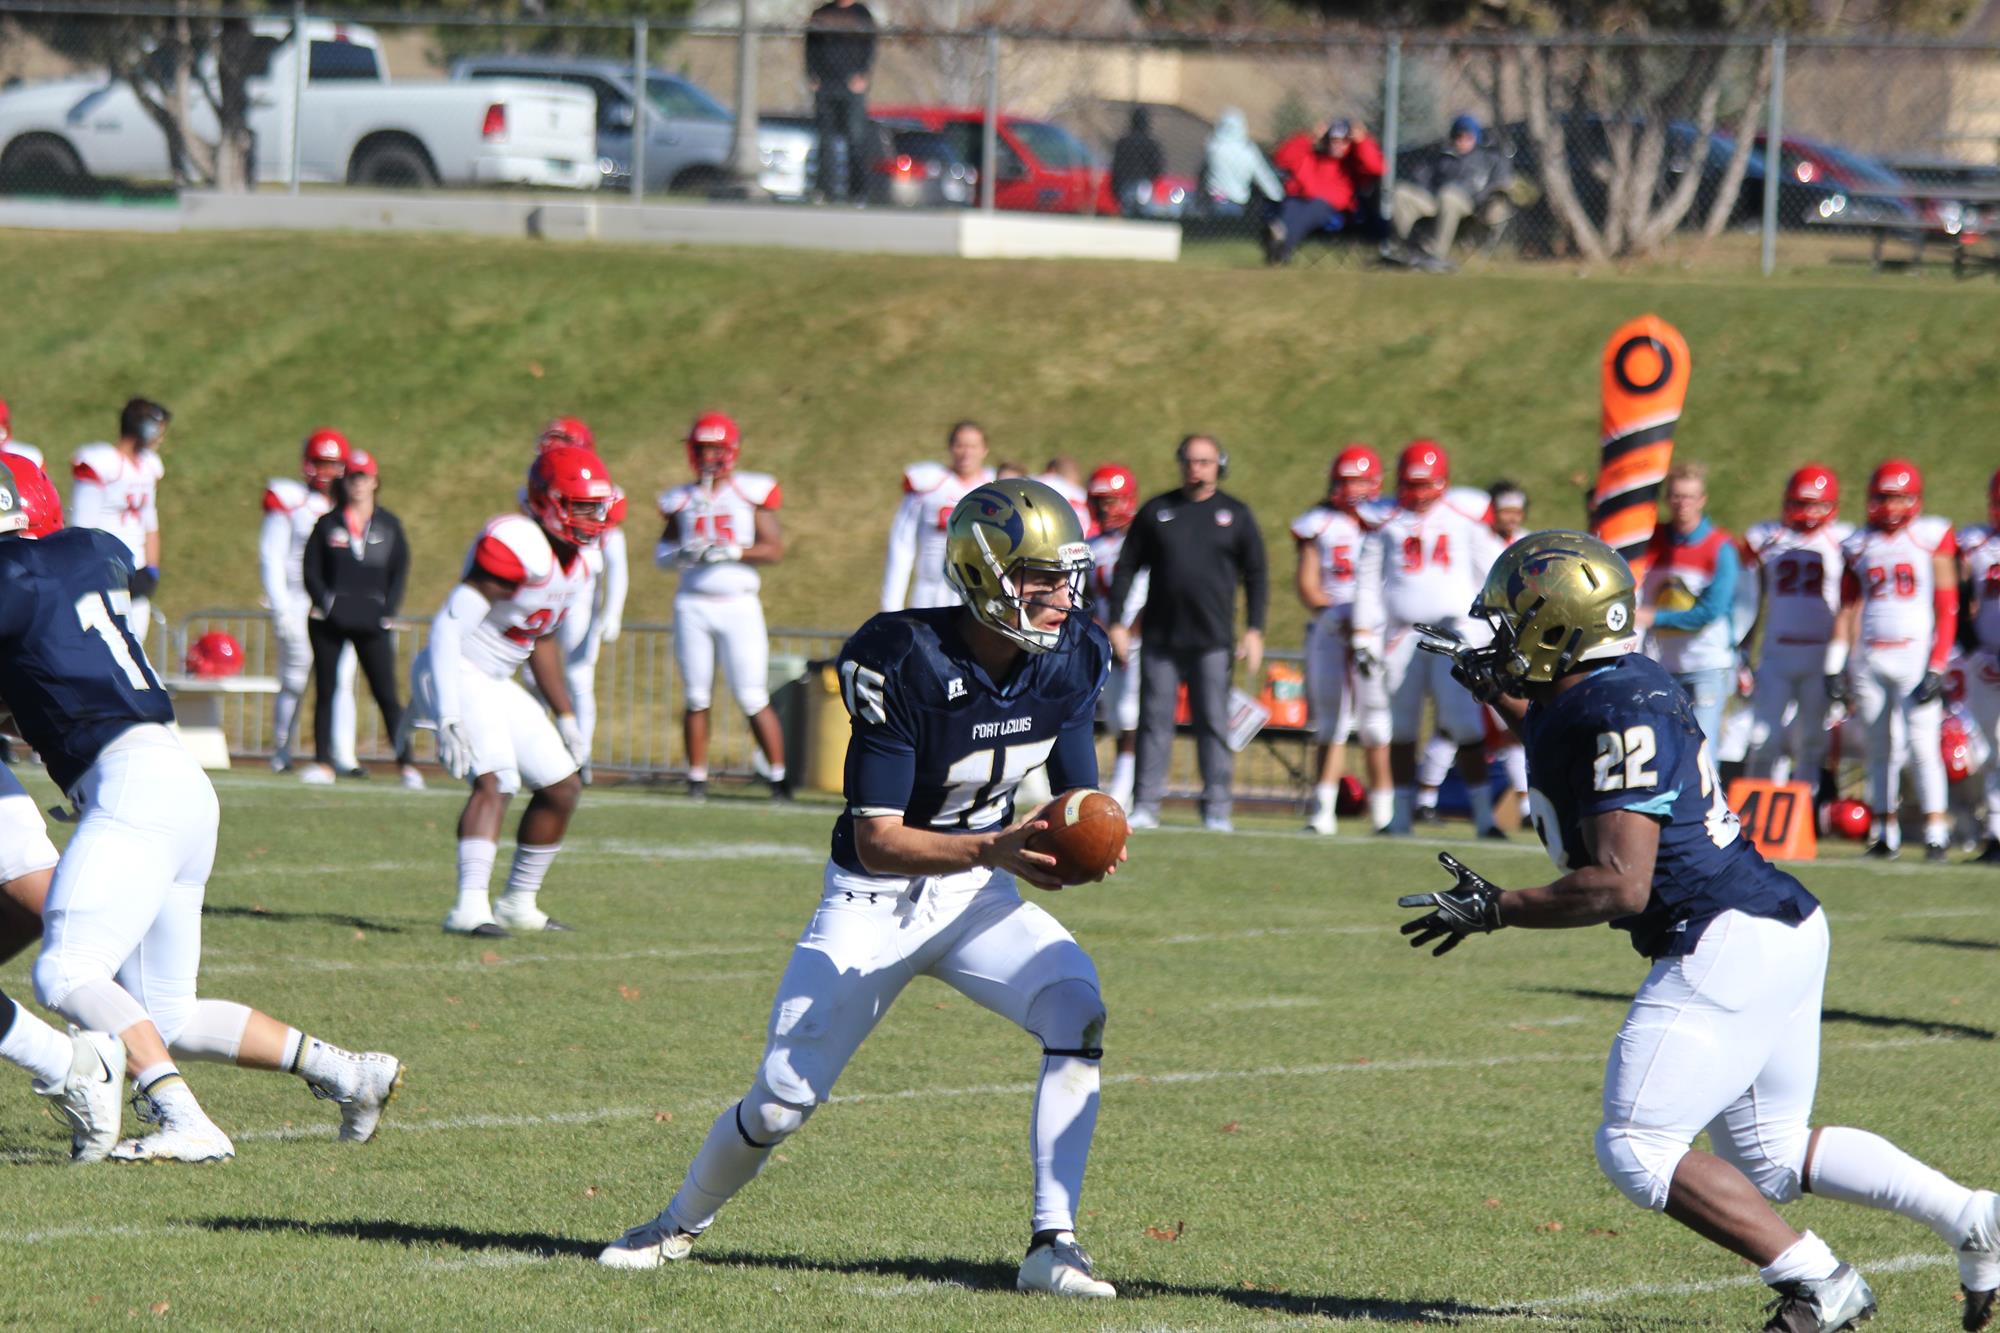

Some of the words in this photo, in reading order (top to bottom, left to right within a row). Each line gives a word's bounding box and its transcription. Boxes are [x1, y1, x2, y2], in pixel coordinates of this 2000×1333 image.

[1401, 534, 1453, 574] 94
[1776, 559, 1823, 598] 22
[841, 660, 886, 725] 15
[972, 722, 1000, 741] FORT
[1000, 716, 1032, 736] LEWIS
[929, 735, 1058, 831] 15
[1593, 724, 1658, 792] 22
